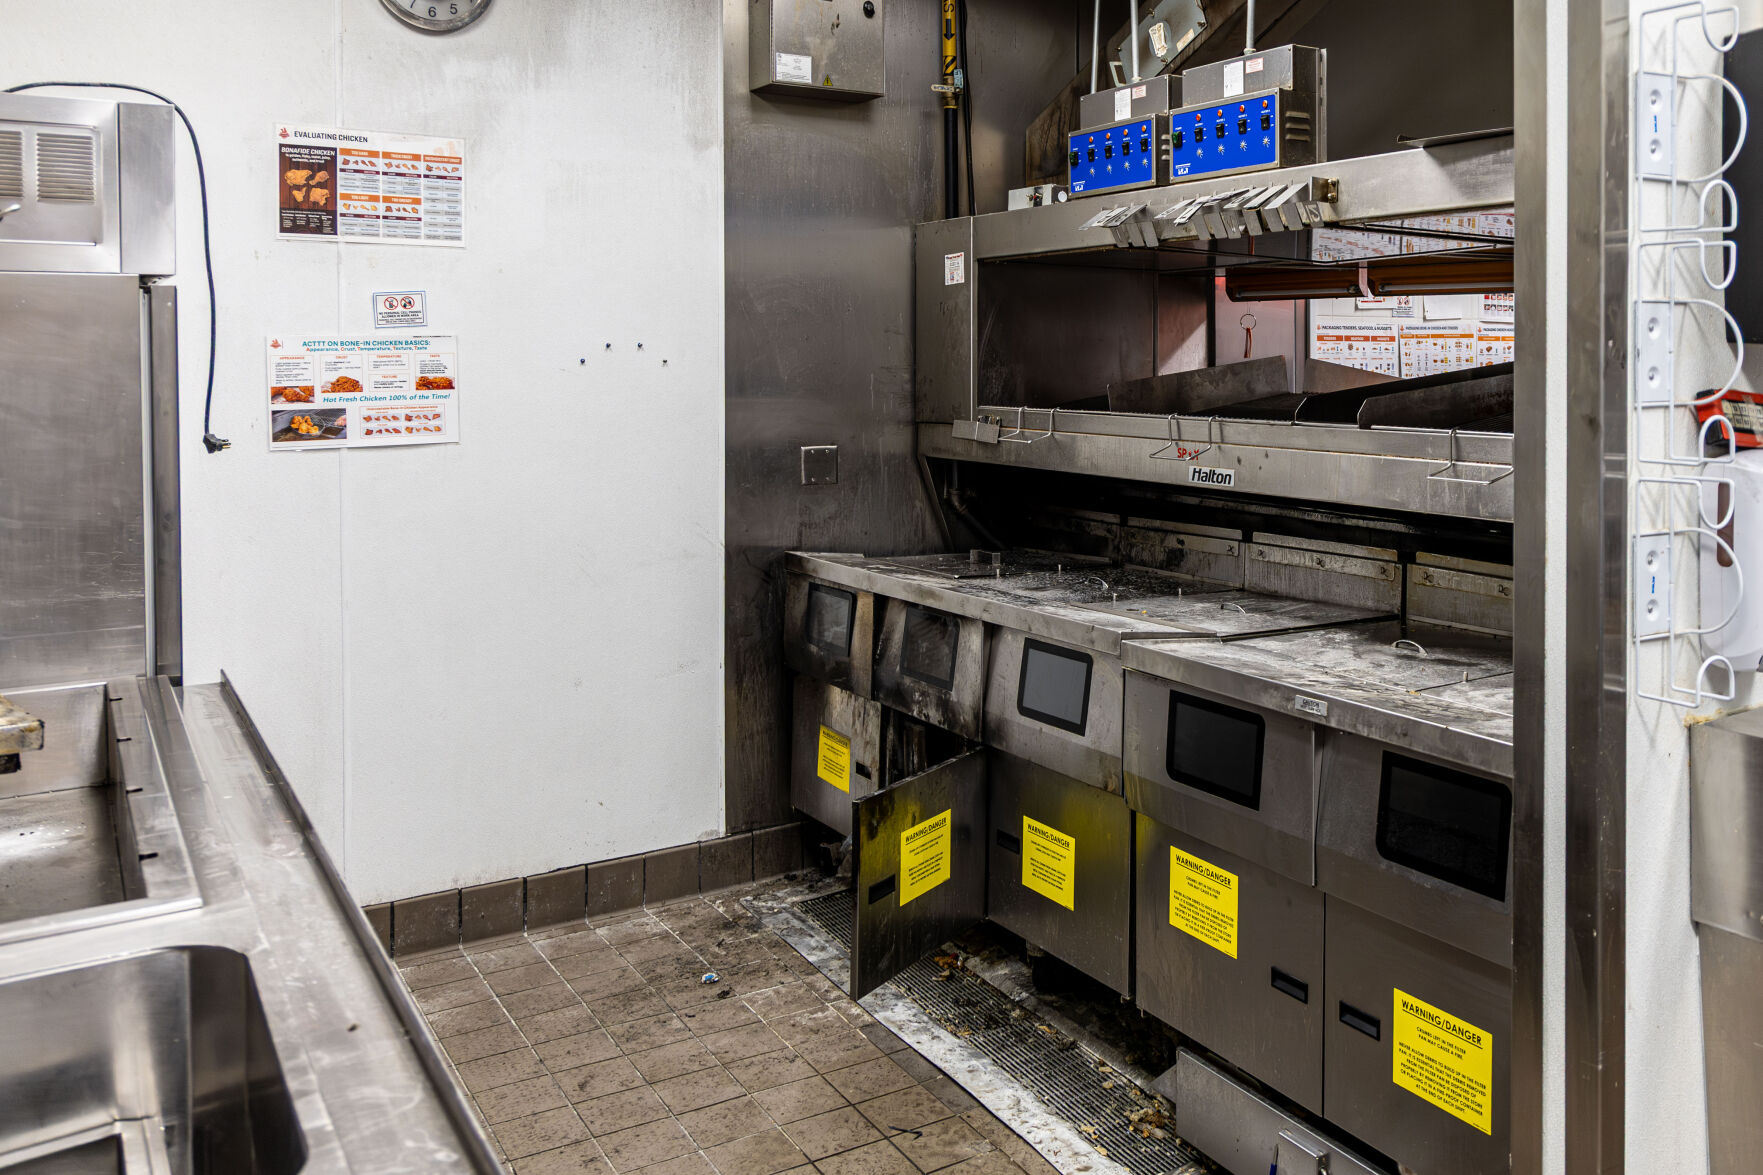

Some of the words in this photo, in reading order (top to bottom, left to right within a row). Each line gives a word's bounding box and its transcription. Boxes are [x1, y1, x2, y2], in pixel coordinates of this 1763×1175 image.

[428, 7, 437, 17] 6
[450, 4, 458, 14] 5
[294, 130, 337, 140] EVALUATING
[338, 134, 368, 142] CHICKEN
[1177, 447, 1199, 460] SPY
[1192, 467, 1232, 485] Halton
[906, 817, 946, 843] WARNING/DANGER
[1028, 824, 1069, 848] WARNING/DANGER
[1176, 854, 1231, 886] WARNING/DANGER
[1401, 999, 1482, 1045] WARNING/DANGER
